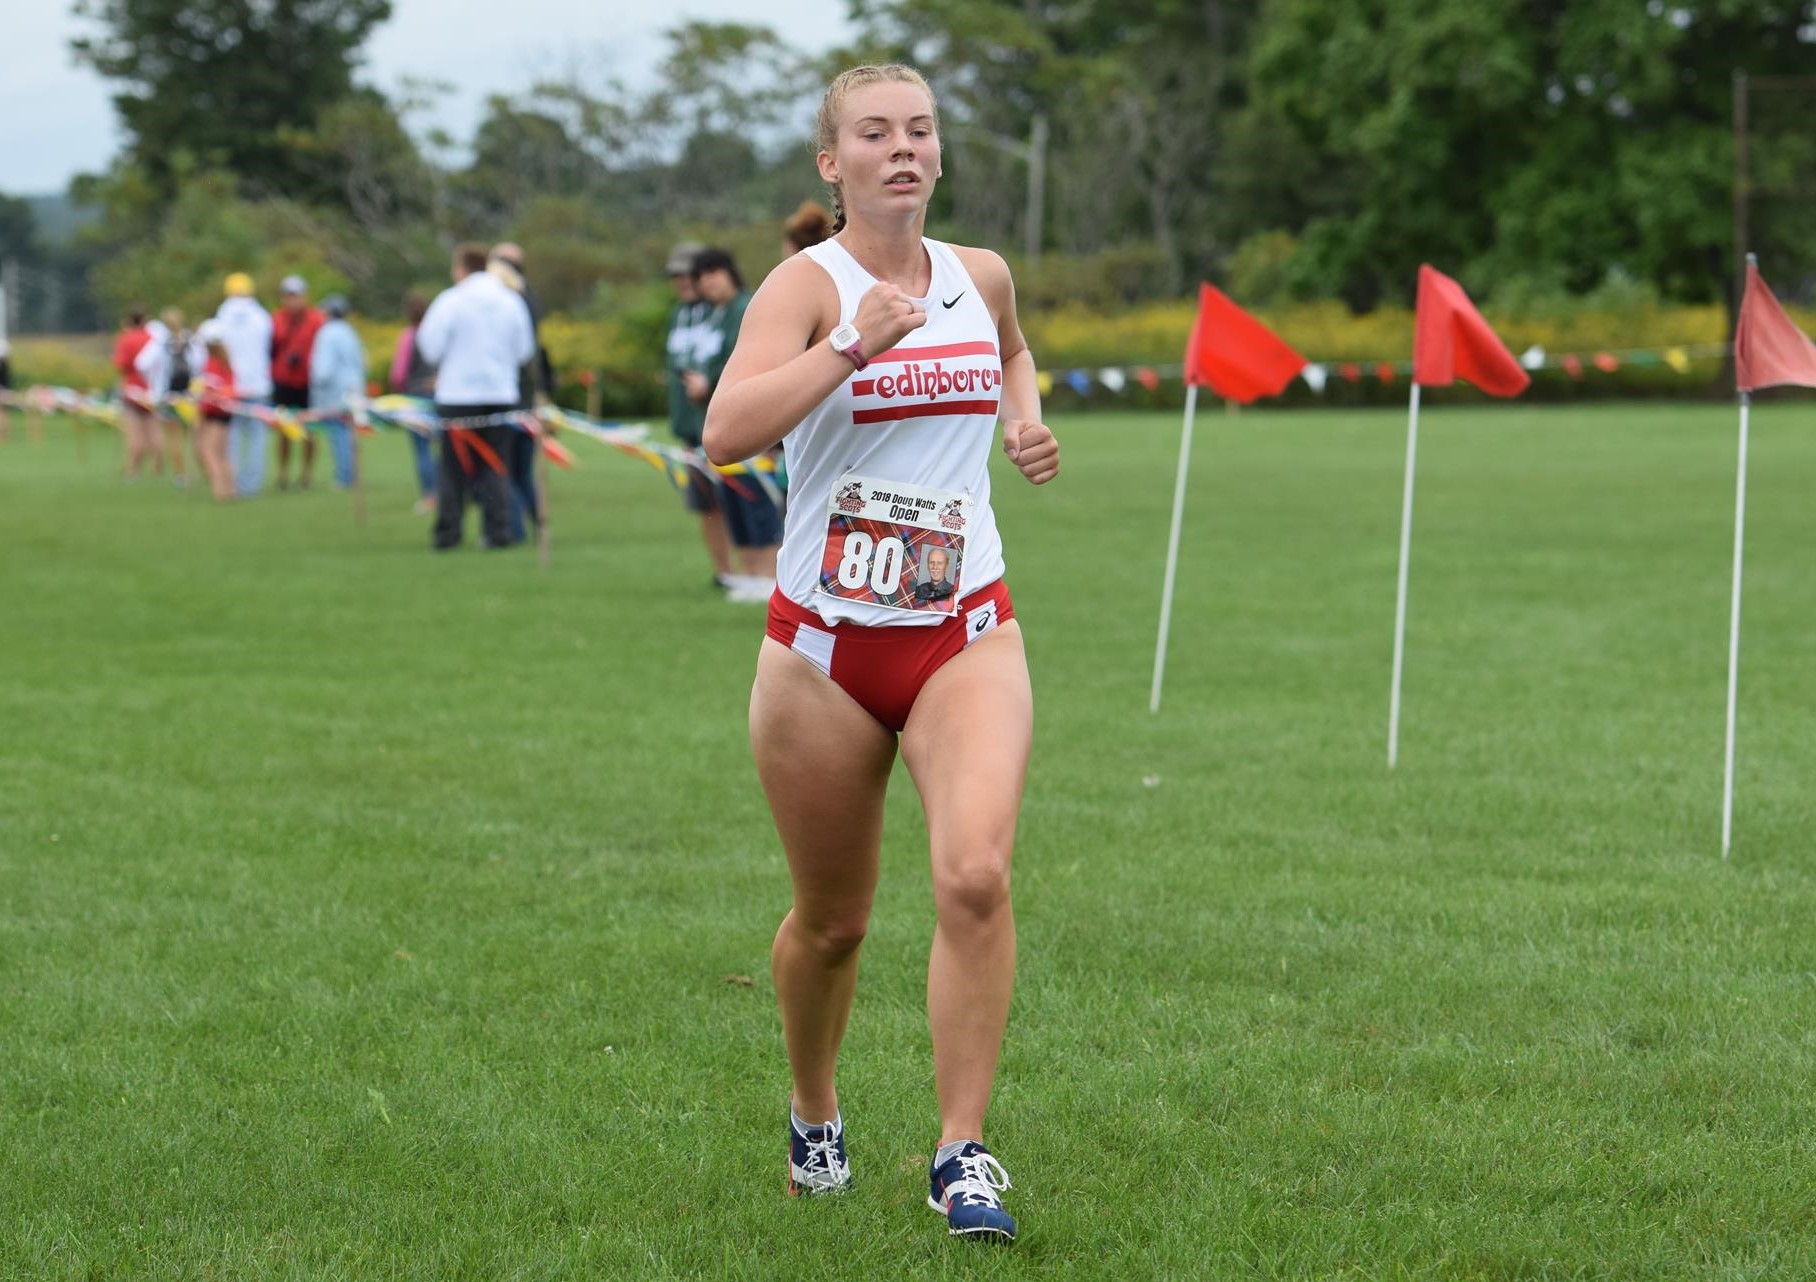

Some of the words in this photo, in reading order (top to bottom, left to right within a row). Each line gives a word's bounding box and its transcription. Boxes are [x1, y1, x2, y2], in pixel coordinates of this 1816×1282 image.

[876, 362, 993, 401] edinboro
[835, 496, 867, 508] FIGHTING
[871, 490, 891, 502] 2018
[892, 494, 914, 507] Doug
[915, 497, 936, 510] Watts
[839, 503, 861, 513] SCOTS
[889, 504, 919, 522] Open
[938, 513, 966, 526] FIGHTING
[941, 520, 962, 530] SCOTS
[838, 532, 904, 595] 80
